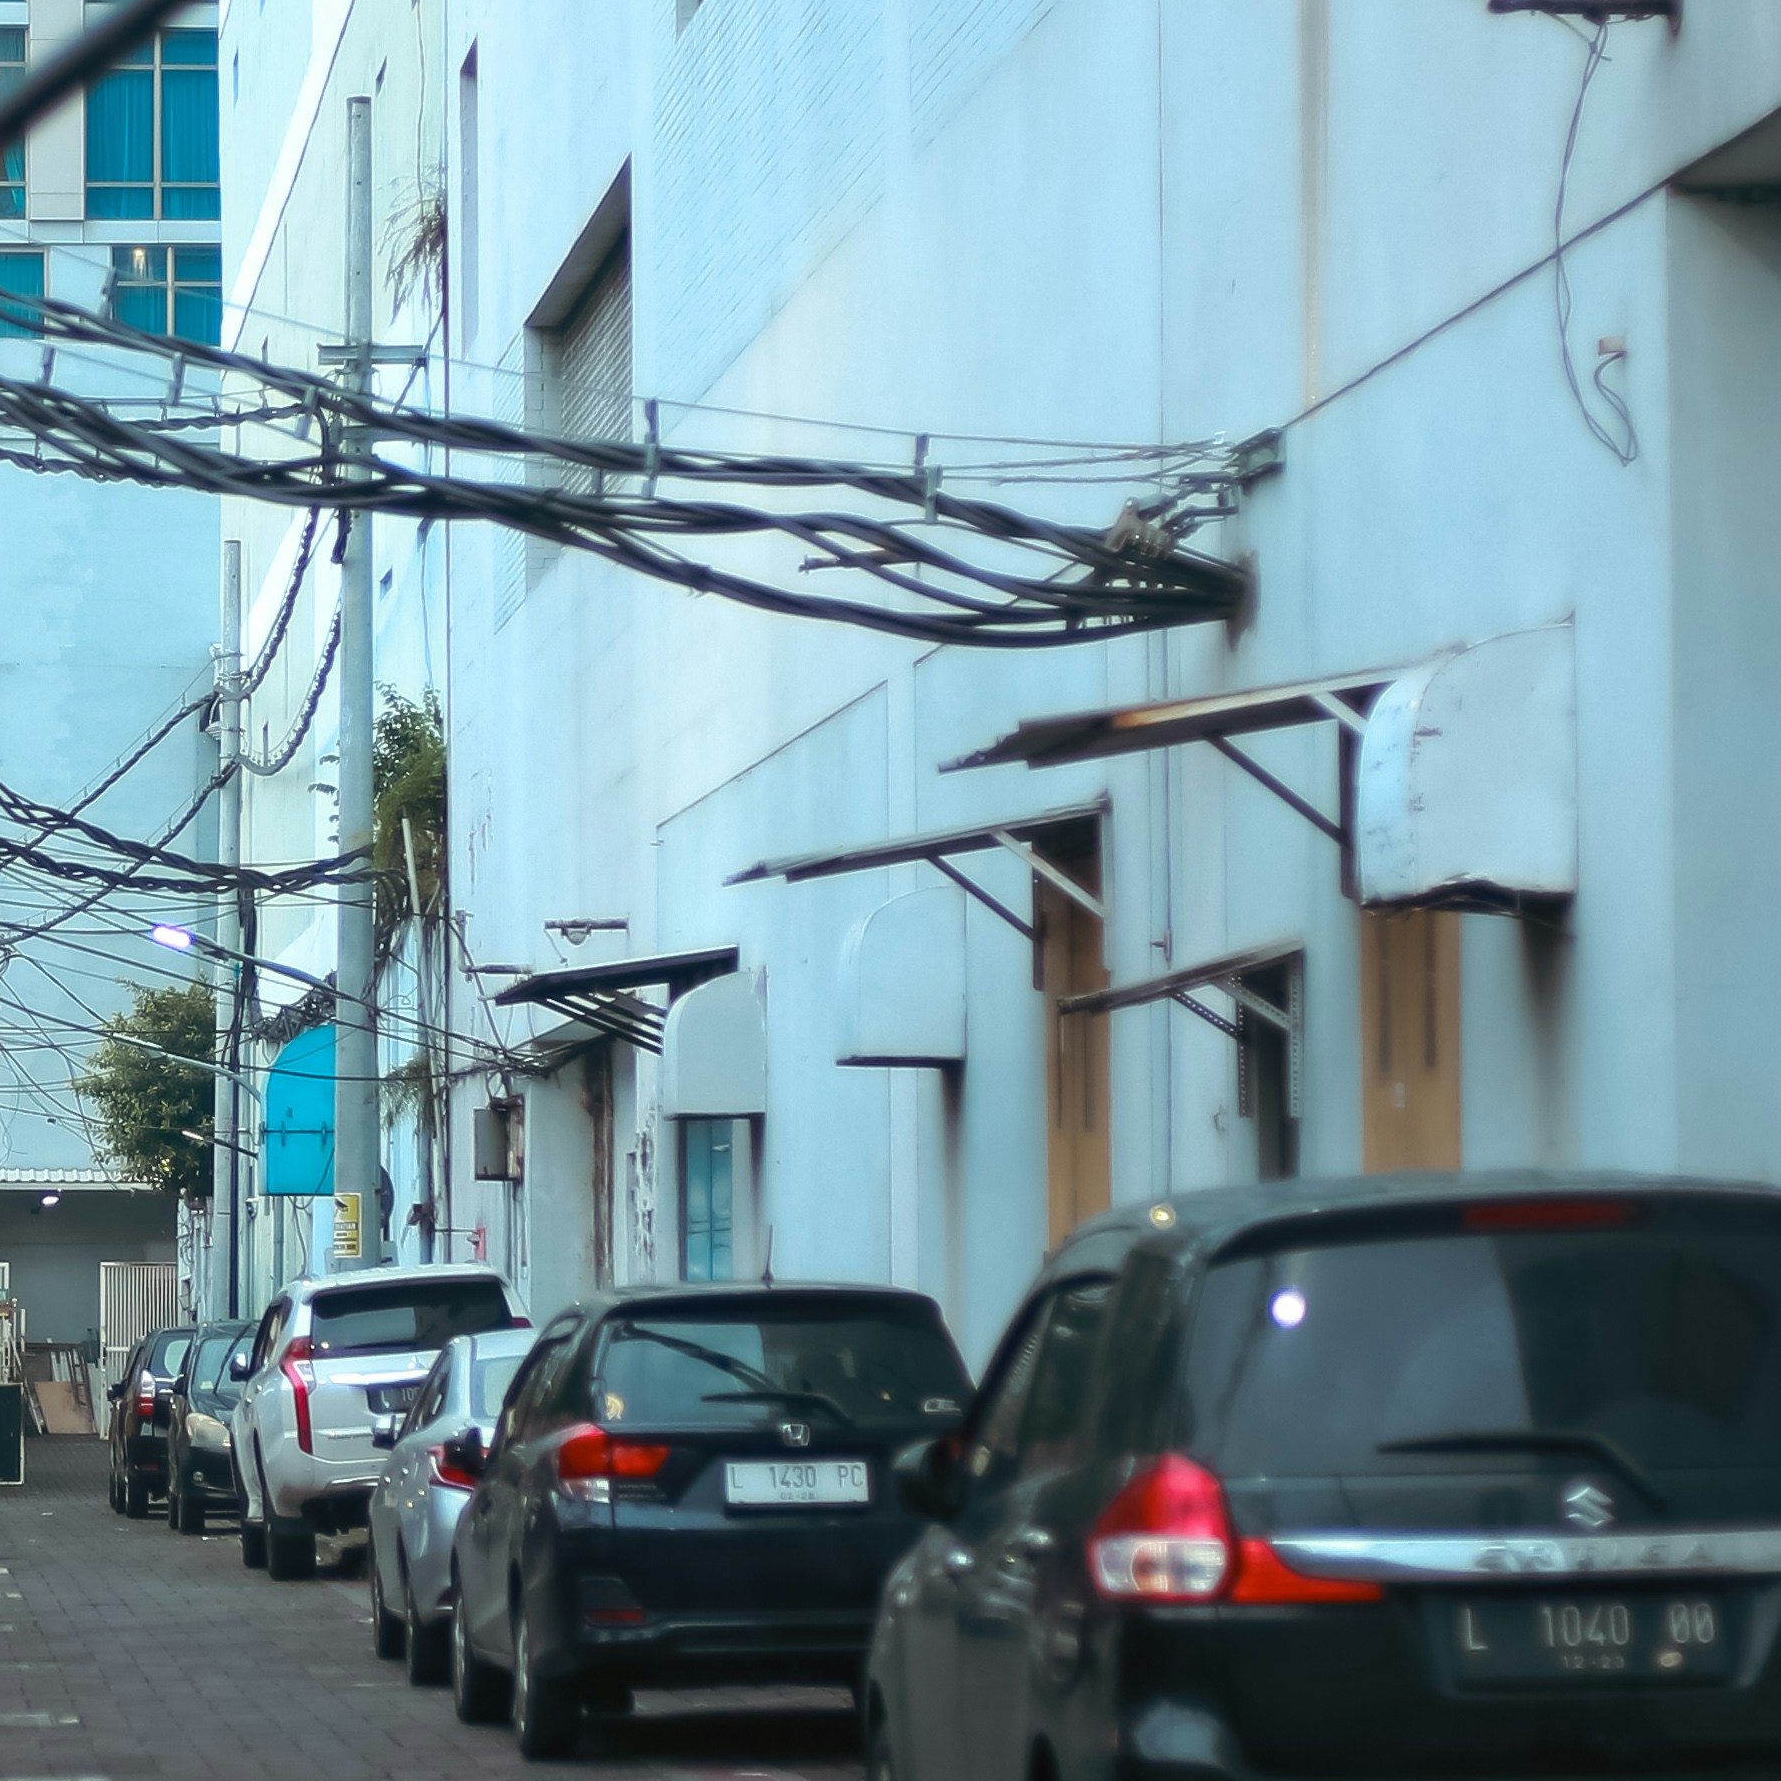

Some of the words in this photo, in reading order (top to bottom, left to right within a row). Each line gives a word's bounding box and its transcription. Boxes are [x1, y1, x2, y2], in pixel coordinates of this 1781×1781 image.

[731, 1466, 744, 1489] L
[769, 1466, 817, 1489] 1430
[838, 1465, 864, 1488] PC
[1467, 1608, 1488, 1651] L
[1542, 1605, 1631, 1648] 1040
